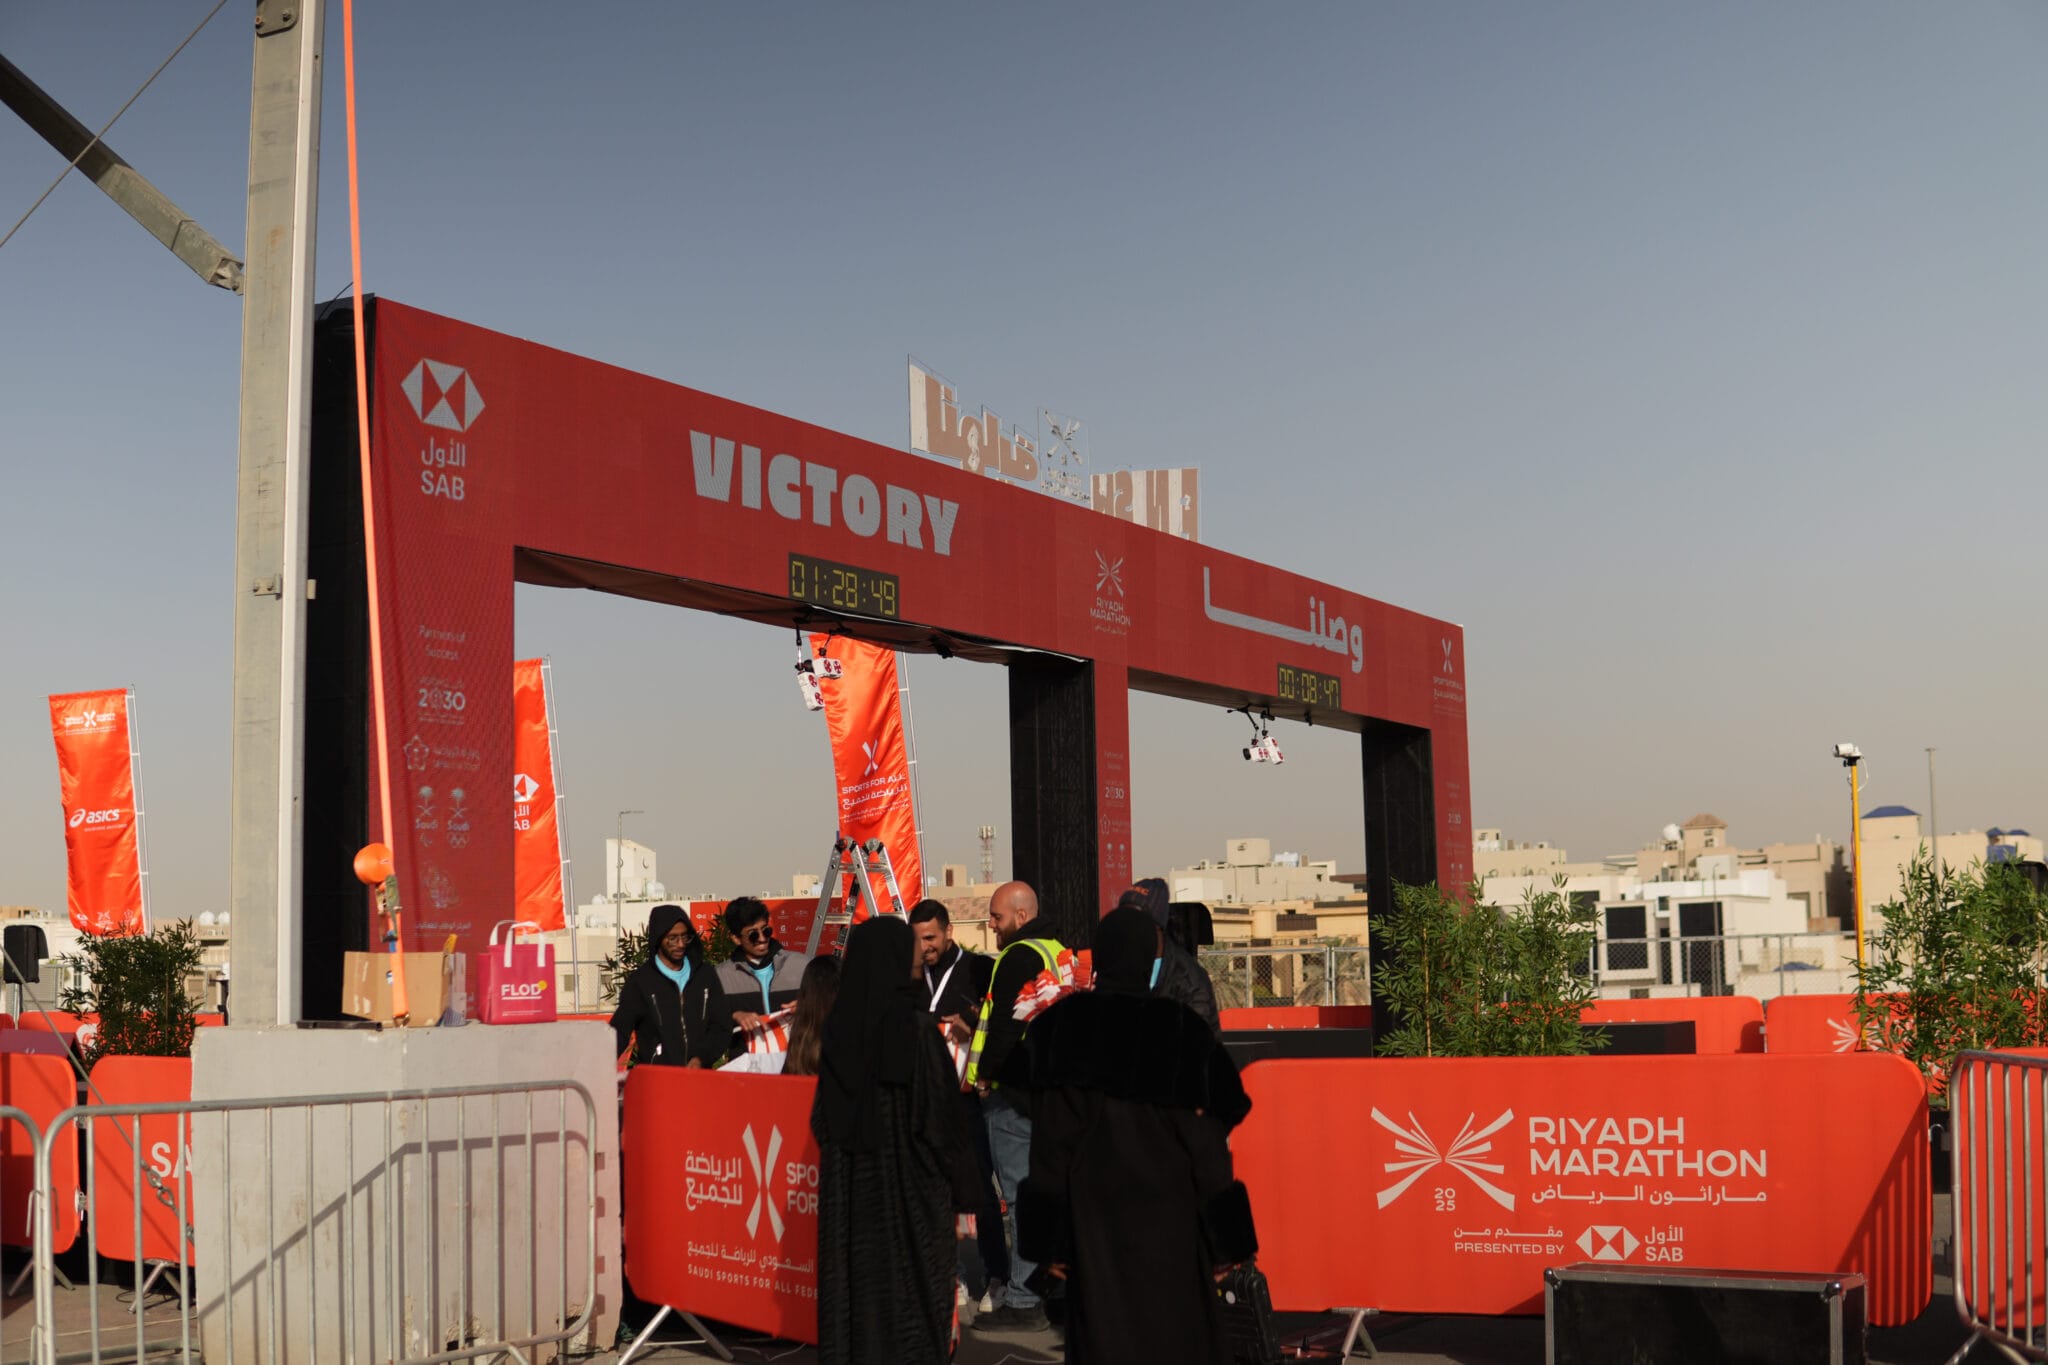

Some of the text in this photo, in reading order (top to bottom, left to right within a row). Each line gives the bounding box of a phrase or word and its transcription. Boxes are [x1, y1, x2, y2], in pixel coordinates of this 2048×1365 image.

[421, 437, 467, 468] الأول
[421, 470, 465, 500] SAB
[689, 430, 960, 557] VICTORY
[792, 560, 895, 616] 01:28:49
[1096, 596, 1124, 613] RIYADH
[1090, 607, 1131, 626] MARATHON
[1279, 667, 1339, 709] 00:08:47
[842, 782, 870, 794] SPORTS
[871, 777, 886, 787] FOR
[86, 809, 120, 824] asics
[1529, 1116, 1685, 1145] RIYADH
[685, 1150, 742, 1182] الرياضة
[1530, 1148, 1767, 1177] MARATHON
[686, 1177, 742, 1211] للجميع
[787, 1190, 818, 1215] FOR
[1434, 1187, 1456, 1199] 20
[1532, 1184, 1767, 1206] ماراثون الرياض
[1435, 1200, 1456, 1211] 25
[1454, 1226, 1563, 1238] مقدم من
[1645, 1226, 1683, 1244] الأول
[687, 1241, 719, 1259] للجميع
[1454, 1242, 1564, 1255] PRESENTED BY
[1645, 1246, 1683, 1262] SAB
[688, 1263, 713, 1279] SAUDI
[716, 1270, 750, 1287] SPORTS
[753, 1276, 771, 1289] FOR
[775, 1281, 793, 1294] ALL
